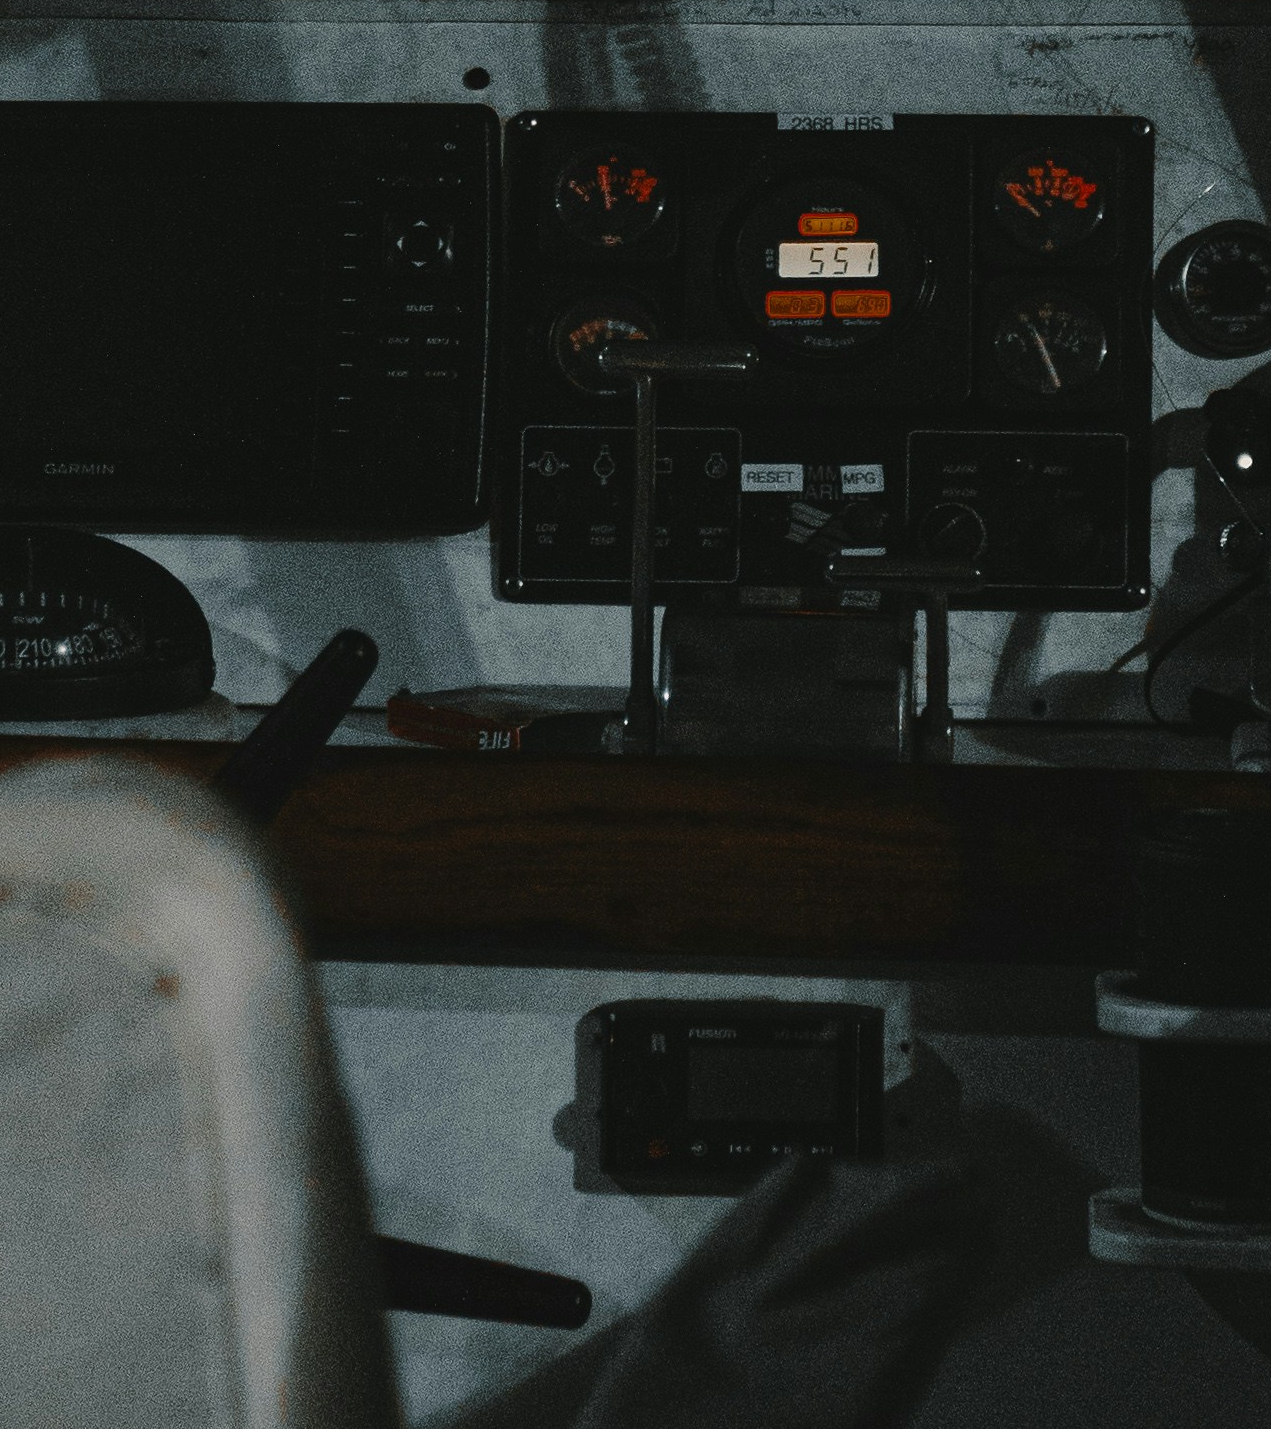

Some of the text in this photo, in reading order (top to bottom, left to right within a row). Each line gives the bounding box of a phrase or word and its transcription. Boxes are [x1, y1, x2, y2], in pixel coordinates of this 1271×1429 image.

[791, 116, 834, 132] 2368
[808, 246, 876, 275] 551
[43, 461, 116, 476] GARMIN
[746, 470, 795, 484] RESET
[842, 470, 877, 485] MPG
[19, 636, 53, 659] 210
